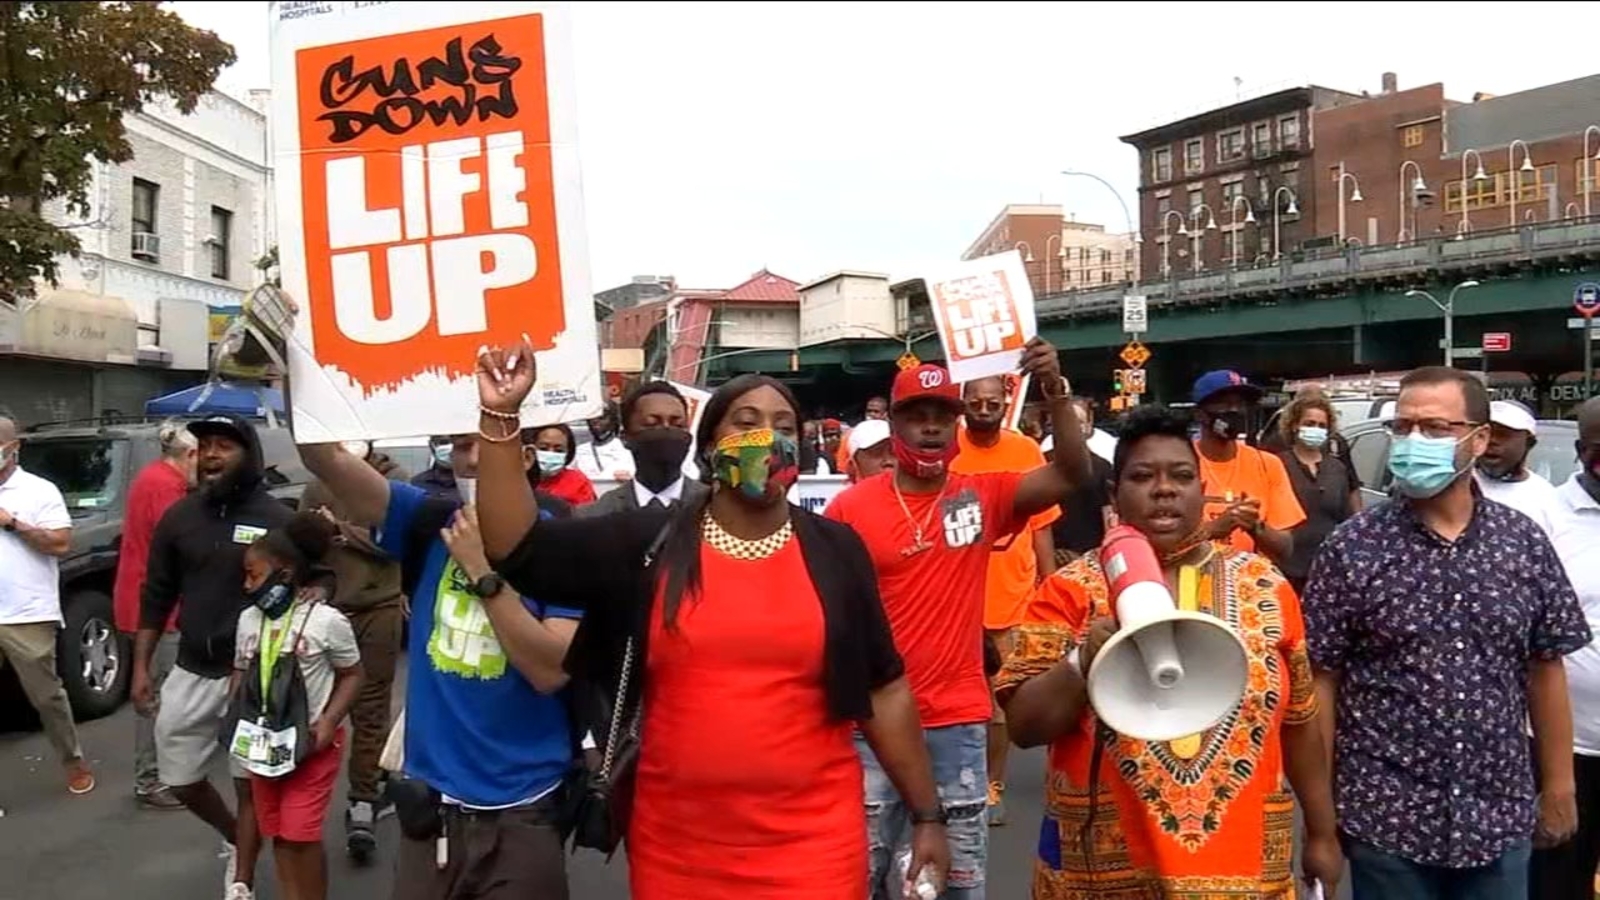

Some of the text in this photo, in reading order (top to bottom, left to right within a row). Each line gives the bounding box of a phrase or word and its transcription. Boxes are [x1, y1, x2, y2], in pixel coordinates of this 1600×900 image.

[319, 33, 522, 108] GUNS
[316, 77, 519, 143] DOWN
[325, 131, 530, 250] LIFE
[331, 233, 538, 345] UP
[1126, 309, 1145, 321] 25
[953, 321, 1016, 357] UP
[943, 502, 982, 530] LIFE
[945, 524, 982, 547] UP
[438, 625, 502, 666] UP
